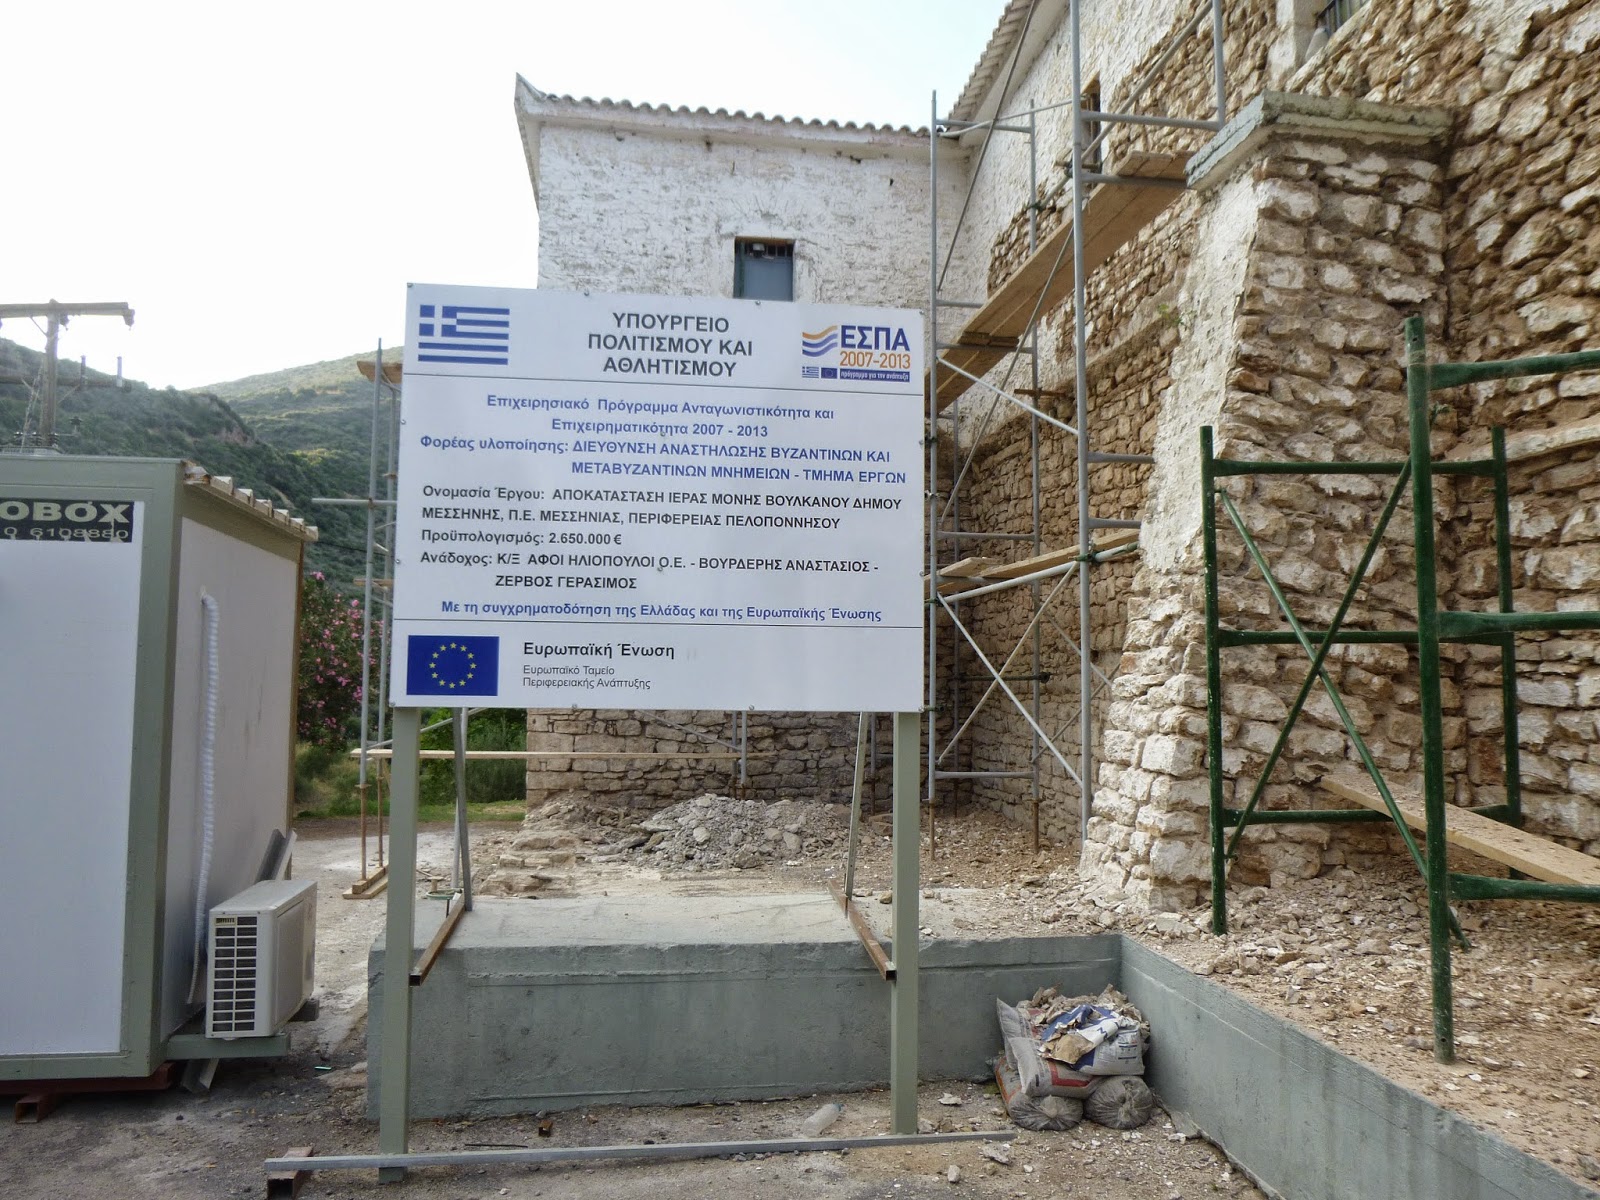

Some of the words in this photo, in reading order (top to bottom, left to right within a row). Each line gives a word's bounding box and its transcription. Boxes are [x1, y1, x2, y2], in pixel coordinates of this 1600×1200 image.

[612, 312, 730, 333] ΥΠΟΥΡΓΕΙΟ
[588, 333, 713, 355] ΠΟΛΙΤΙΣΜΟΥ
[719, 339, 753, 357] ΚΑΙ
[840, 324, 910, 352] ΕΣΠΑ
[602, 356, 737, 378] ΑΘΛΗΤΙΣΜΟΥ
[840, 350, 911, 369] 2007-2013
[487, 394, 590, 411] Επιχειρησιακό
[597, 398, 679, 416] Πρόγραμμα
[681, 401, 811, 421] Ανταγωνιστικότητα
[814, 409, 834, 419] και
[551, 418, 689, 438] Επιχειρηματικότητα
[692, 423, 724, 436] 2007
[736, 424, 768, 438] 2013
[420, 435, 475, 452] Φορέας
[479, 437, 569, 455] υλοποίησης:
[572, 440, 656, 455] ΔΙΕΥΘΥΝΣΗ
[659, 443, 767, 458] ΑΝΑΣΤΗΛΩΣΗΣ
[771, 446, 863, 462] ΒΥΖΑΝΤΙΝΩΝ
[866, 450, 890, 463] ΚΑΙ
[571, 461, 707, 478] ΜΕΤΑΒΥΖΑΝΤΙΝΩΝ
[711, 465, 790, 480] ΜΝΗΜΕΙΩΝ
[802, 468, 855, 482] ΤΜΗΜΑ
[858, 470, 906, 484] ΕΡΓΩΝ
[422, 484, 491, 500] Ονομασία
[494, 486, 545, 502] Έργου:
[551, 488, 665, 503] ΑΠΟΚΑΤΑΣΤΑΣΗ
[668, 491, 708, 505] ΙΕΡΑΣ
[711, 493, 762, 506] ΜΟΝΗΣ
[765, 494, 851, 510] ΒΟΥΛΚΑΝΟΥ
[852, 497, 902, 510] ΔΗΜΟΥ
[422, 507, 504, 523] ΜΕΣΣΗΝΗΣ,
[508, 509, 536, 522] Π.Ε.
[539, 510, 624, 526] ΜΕΣΣΗΝΙΑΣ,
[628, 511, 723, 526] ΠΕΡΙΦΕΡΕΙΑΣ
[725, 513, 841, 529] ΠΕΛΟΠΟΝΝΗΣΟΥ
[421, 529, 544, 547] Προϋπολογισμός:
[548, 532, 611, 545] 2.650.000
[613, 533, 622, 546] €
[420, 551, 493, 567] Ανάδοχος:
[496, 552, 521, 565] Κ/Ξ
[527, 553, 564, 566] ΑΦΟΙ
[568, 554, 655, 568] ΗΛΙΟΠΟΥΛΟΙ
[657, 556, 686, 569] Ο.Ε.
[698, 557, 783, 571] ΒΟΥΡΔΕΡΗΣ
[785, 559, 870, 573] ΑΝΑΣΤΑΣΙΟΣ
[495, 574, 554, 588] ΖΕΡΒΟΣ
[557, 576, 637, 589] ΓΕΡΑΣΙΜΟΣ
[441, 600, 461, 613] Με
[463, 603, 479, 616] τη
[481, 603, 612, 618] συγχρηματοδότηση
[614, 606, 637, 619] της
[640, 604, 696, 620] Ελλάδας
[699, 607, 719, 620] και
[721, 608, 743, 622] της
[746, 606, 826, 623] Ευρωπαϊκής
[827, 607, 882, 623] Ένωσης
[523, 641, 613, 660] Ευρωπαϊκή
[616, 643, 675, 660] Ένωση
[522, 664, 581, 678] Ευρωπαϊκό
[581, 665, 615, 679] Ταμείο
[522, 676, 596, 690] Περιφερειακής
[596, 677, 652, 690] Ανάπτυξης
